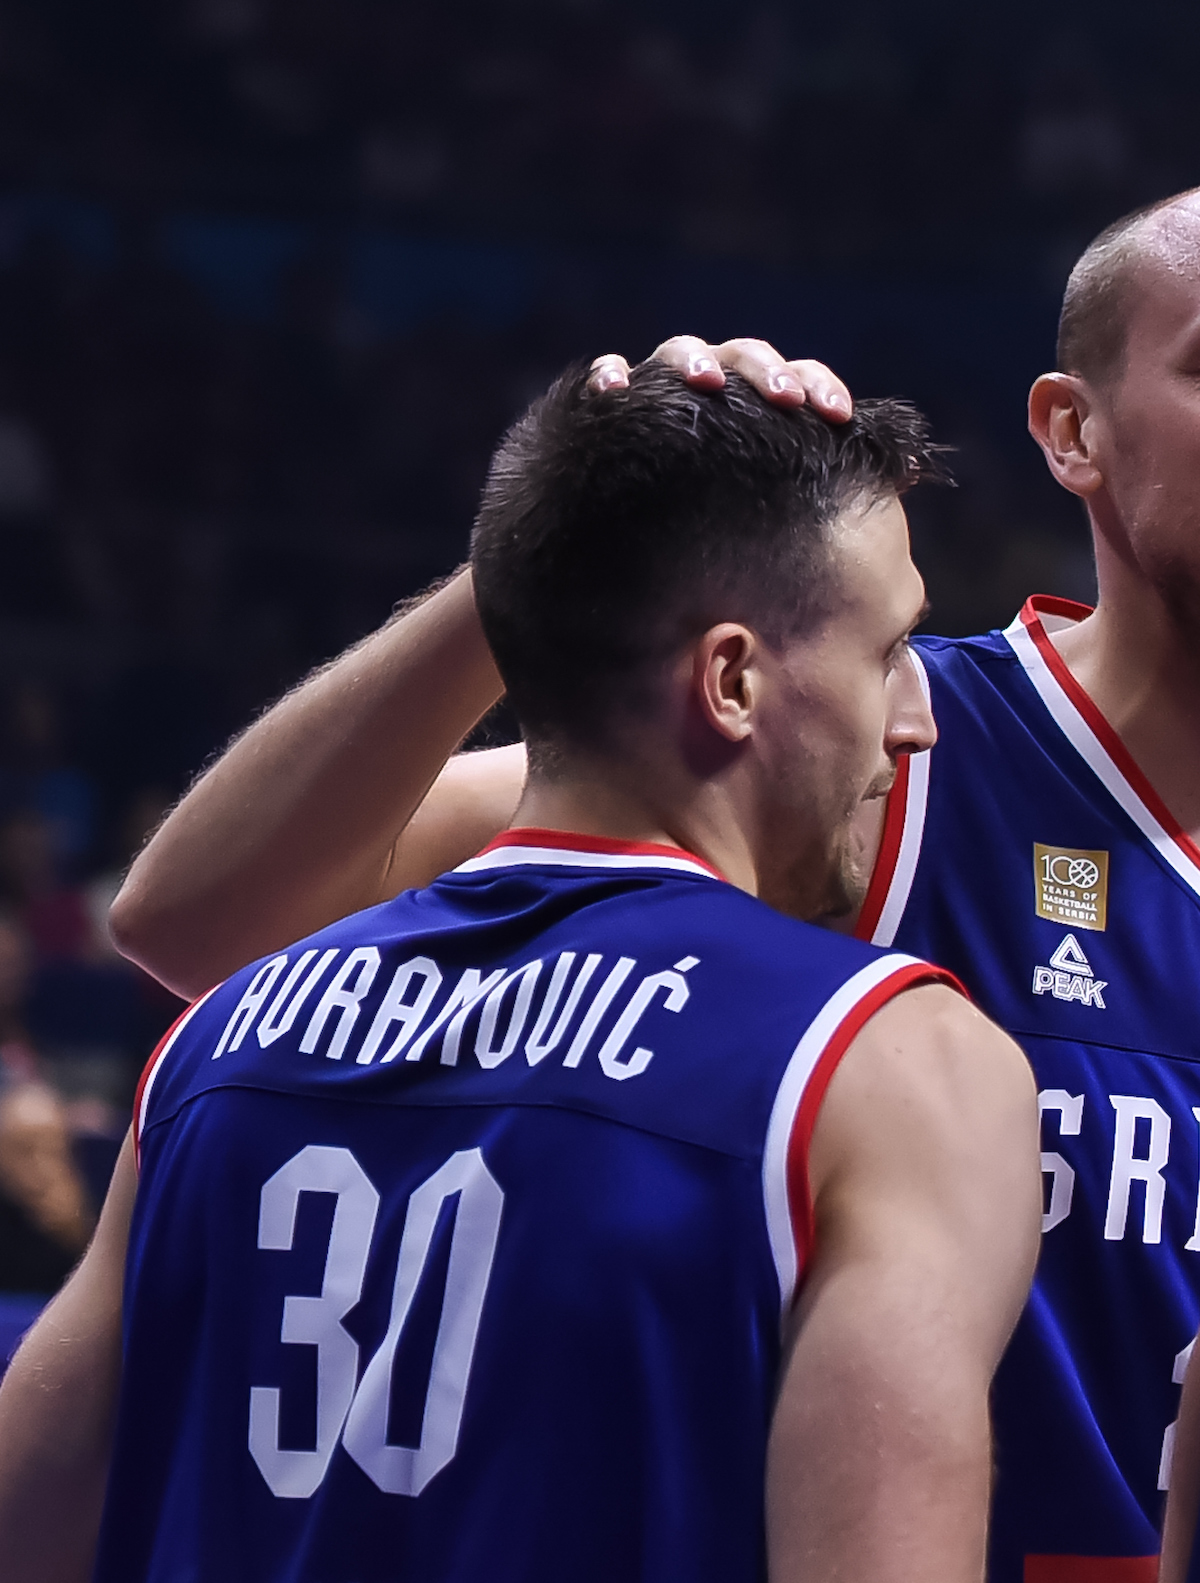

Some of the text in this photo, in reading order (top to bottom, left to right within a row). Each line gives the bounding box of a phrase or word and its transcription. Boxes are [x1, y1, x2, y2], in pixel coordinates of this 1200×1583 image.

[1042, 884, 1098, 901] YEARS OF
[1042, 893, 1098, 912] BASKETBALL
[1042, 903, 1097, 922] IN SERBIA
[1032, 965, 1109, 1009] PEAK
[211, 946, 701, 1081] AVRAMOVIĆ
[248, 1144, 505, 1499] 30
